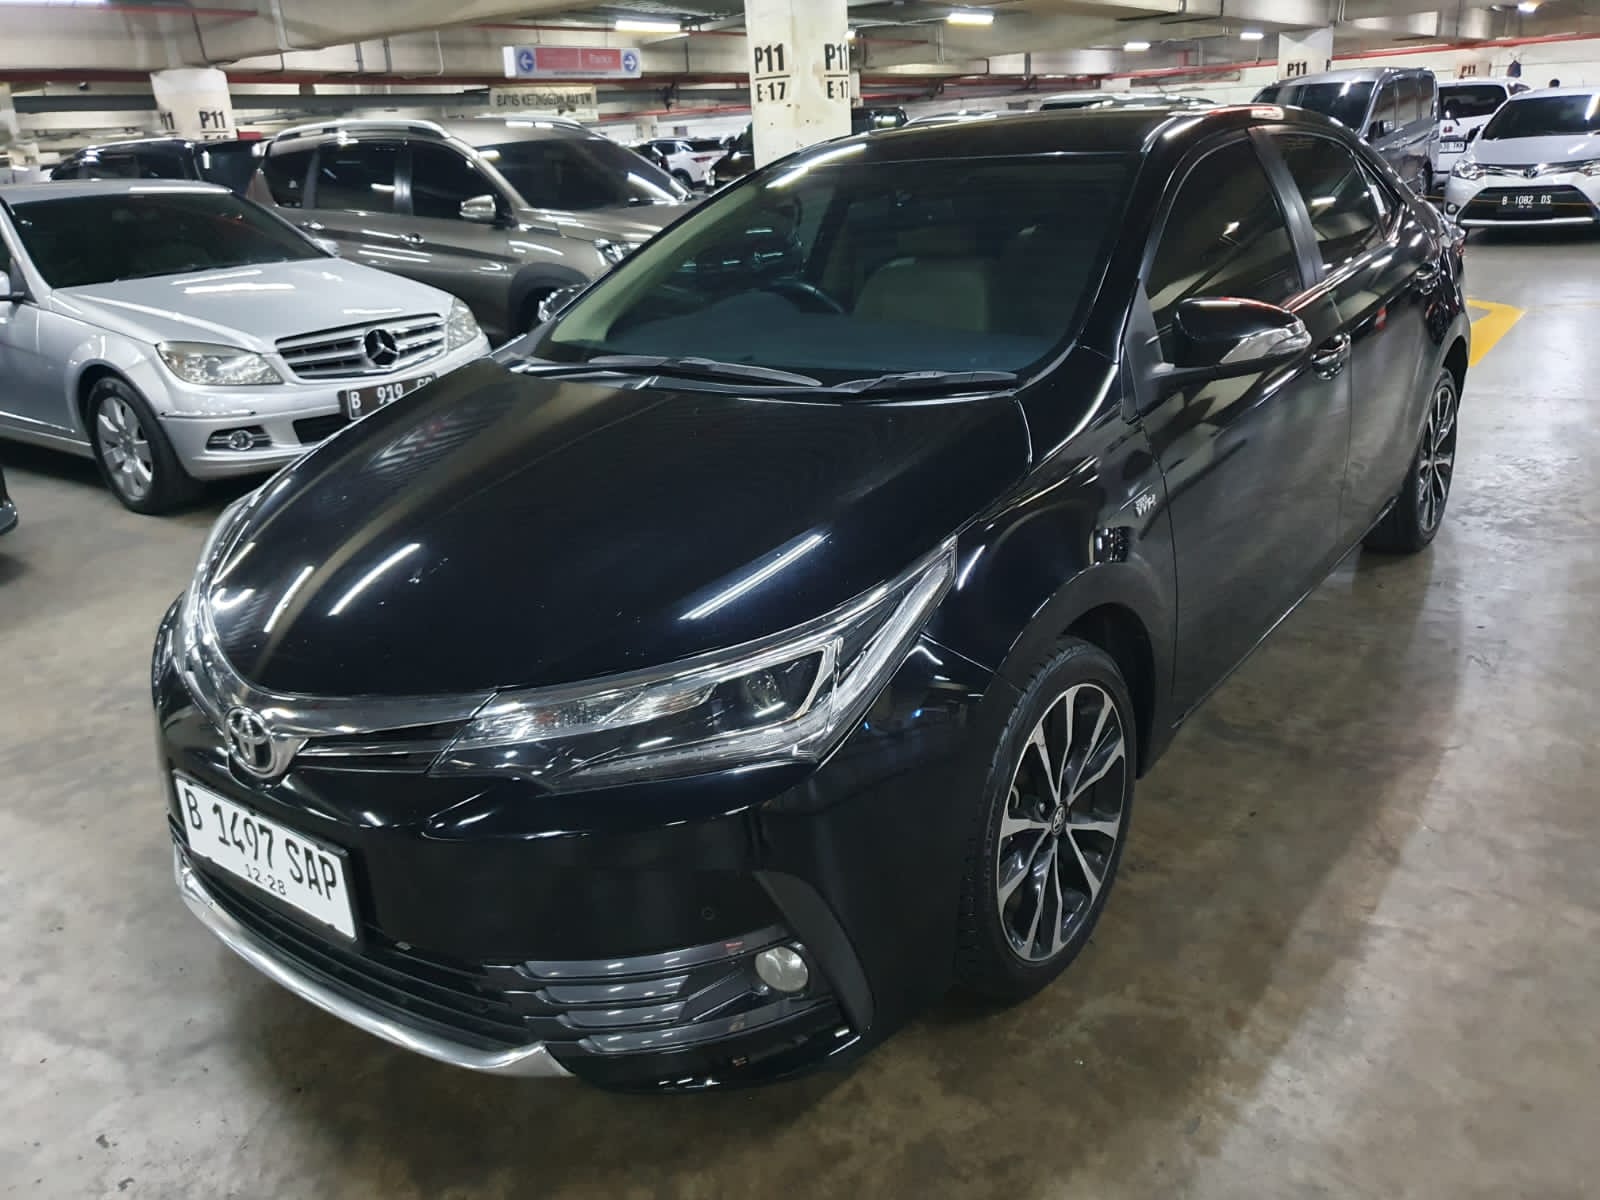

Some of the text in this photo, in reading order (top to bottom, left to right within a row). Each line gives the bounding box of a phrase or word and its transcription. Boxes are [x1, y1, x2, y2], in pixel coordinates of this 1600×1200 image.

[754, 43, 785, 74] P11
[824, 43, 849, 71] P11
[1287, 61, 1308, 76] P11
[199, 110, 226, 129] P11
[350, 391, 361, 409] B
[184, 788, 337, 900] B 1497 SAP
